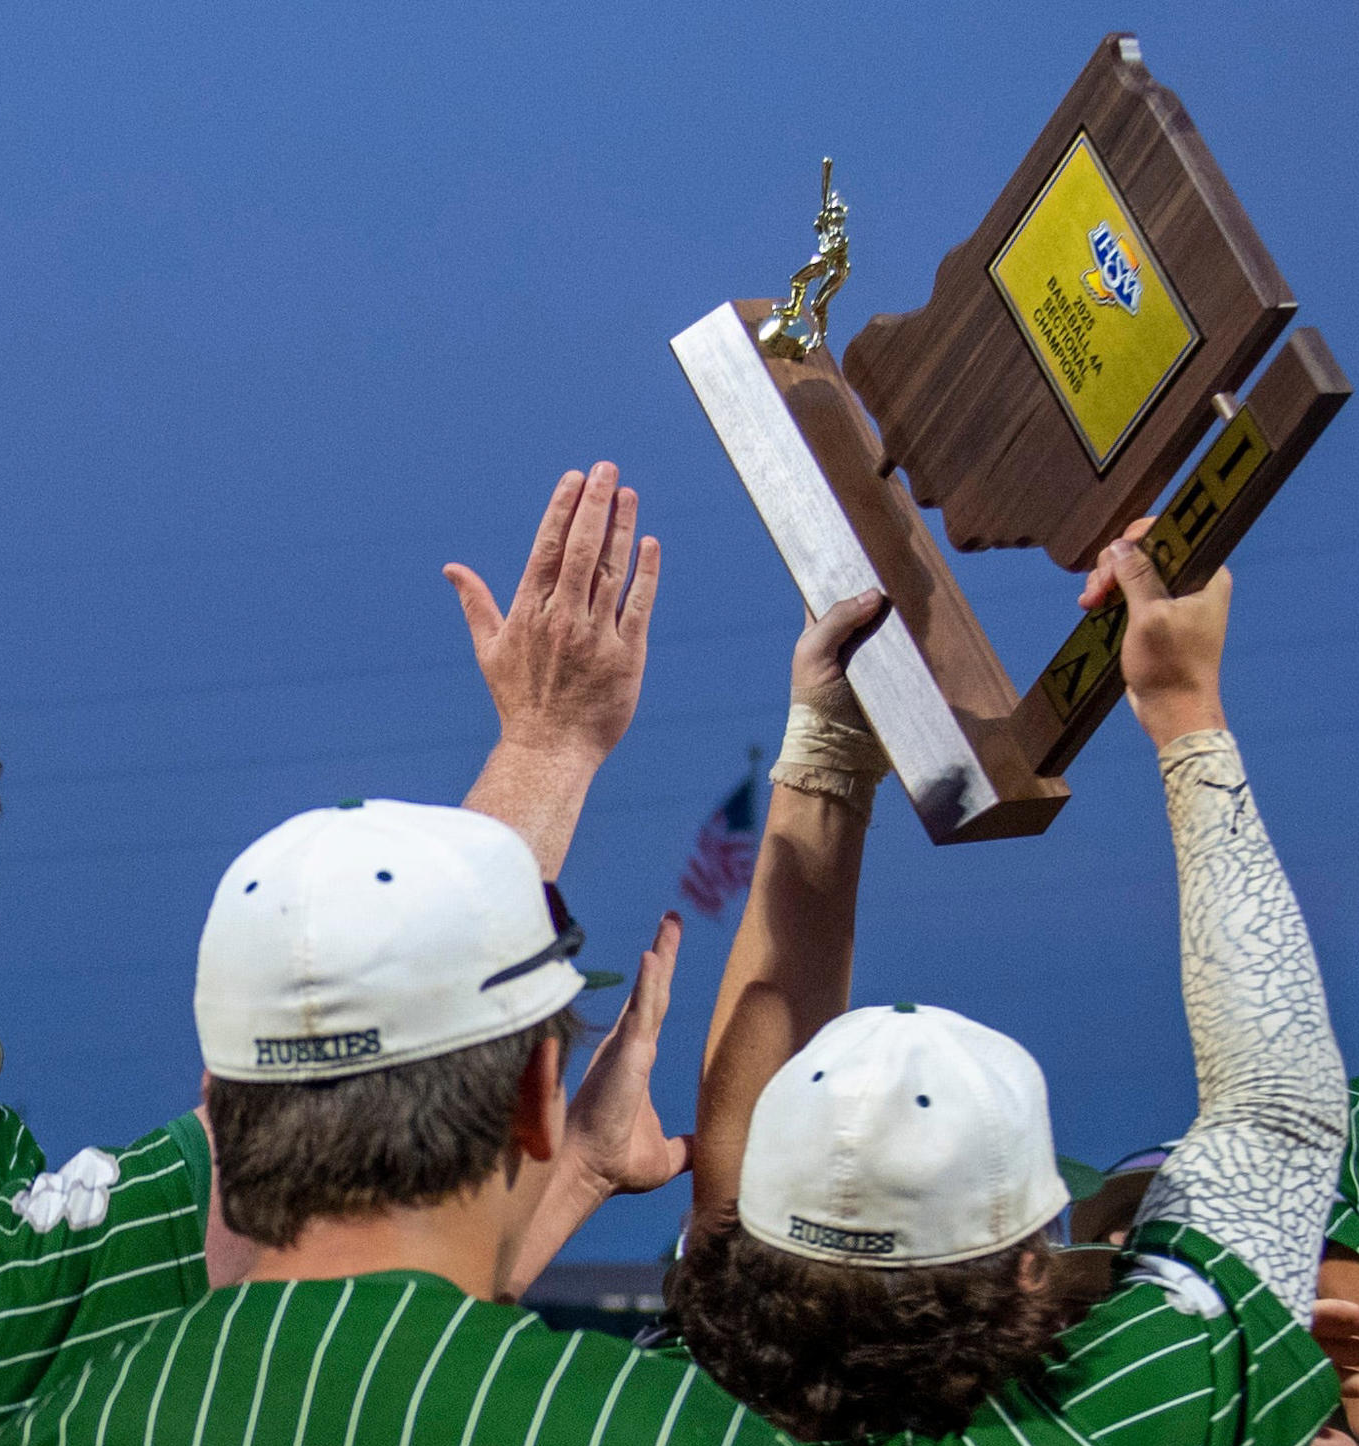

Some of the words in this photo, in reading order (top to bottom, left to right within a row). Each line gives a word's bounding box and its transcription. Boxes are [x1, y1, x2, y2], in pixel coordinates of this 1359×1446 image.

[1044, 297, 1089, 378] SECTIONAL
[1046, 276, 1091, 357] BASEBALL
[1089, 352, 1103, 377] 4A
[1073, 295, 1096, 331] 2025
[1032, 307, 1082, 395] CHAMPIONS
[255, 1027, 382, 1066] HUSKIES
[789, 1214, 896, 1254] HUSKIES
